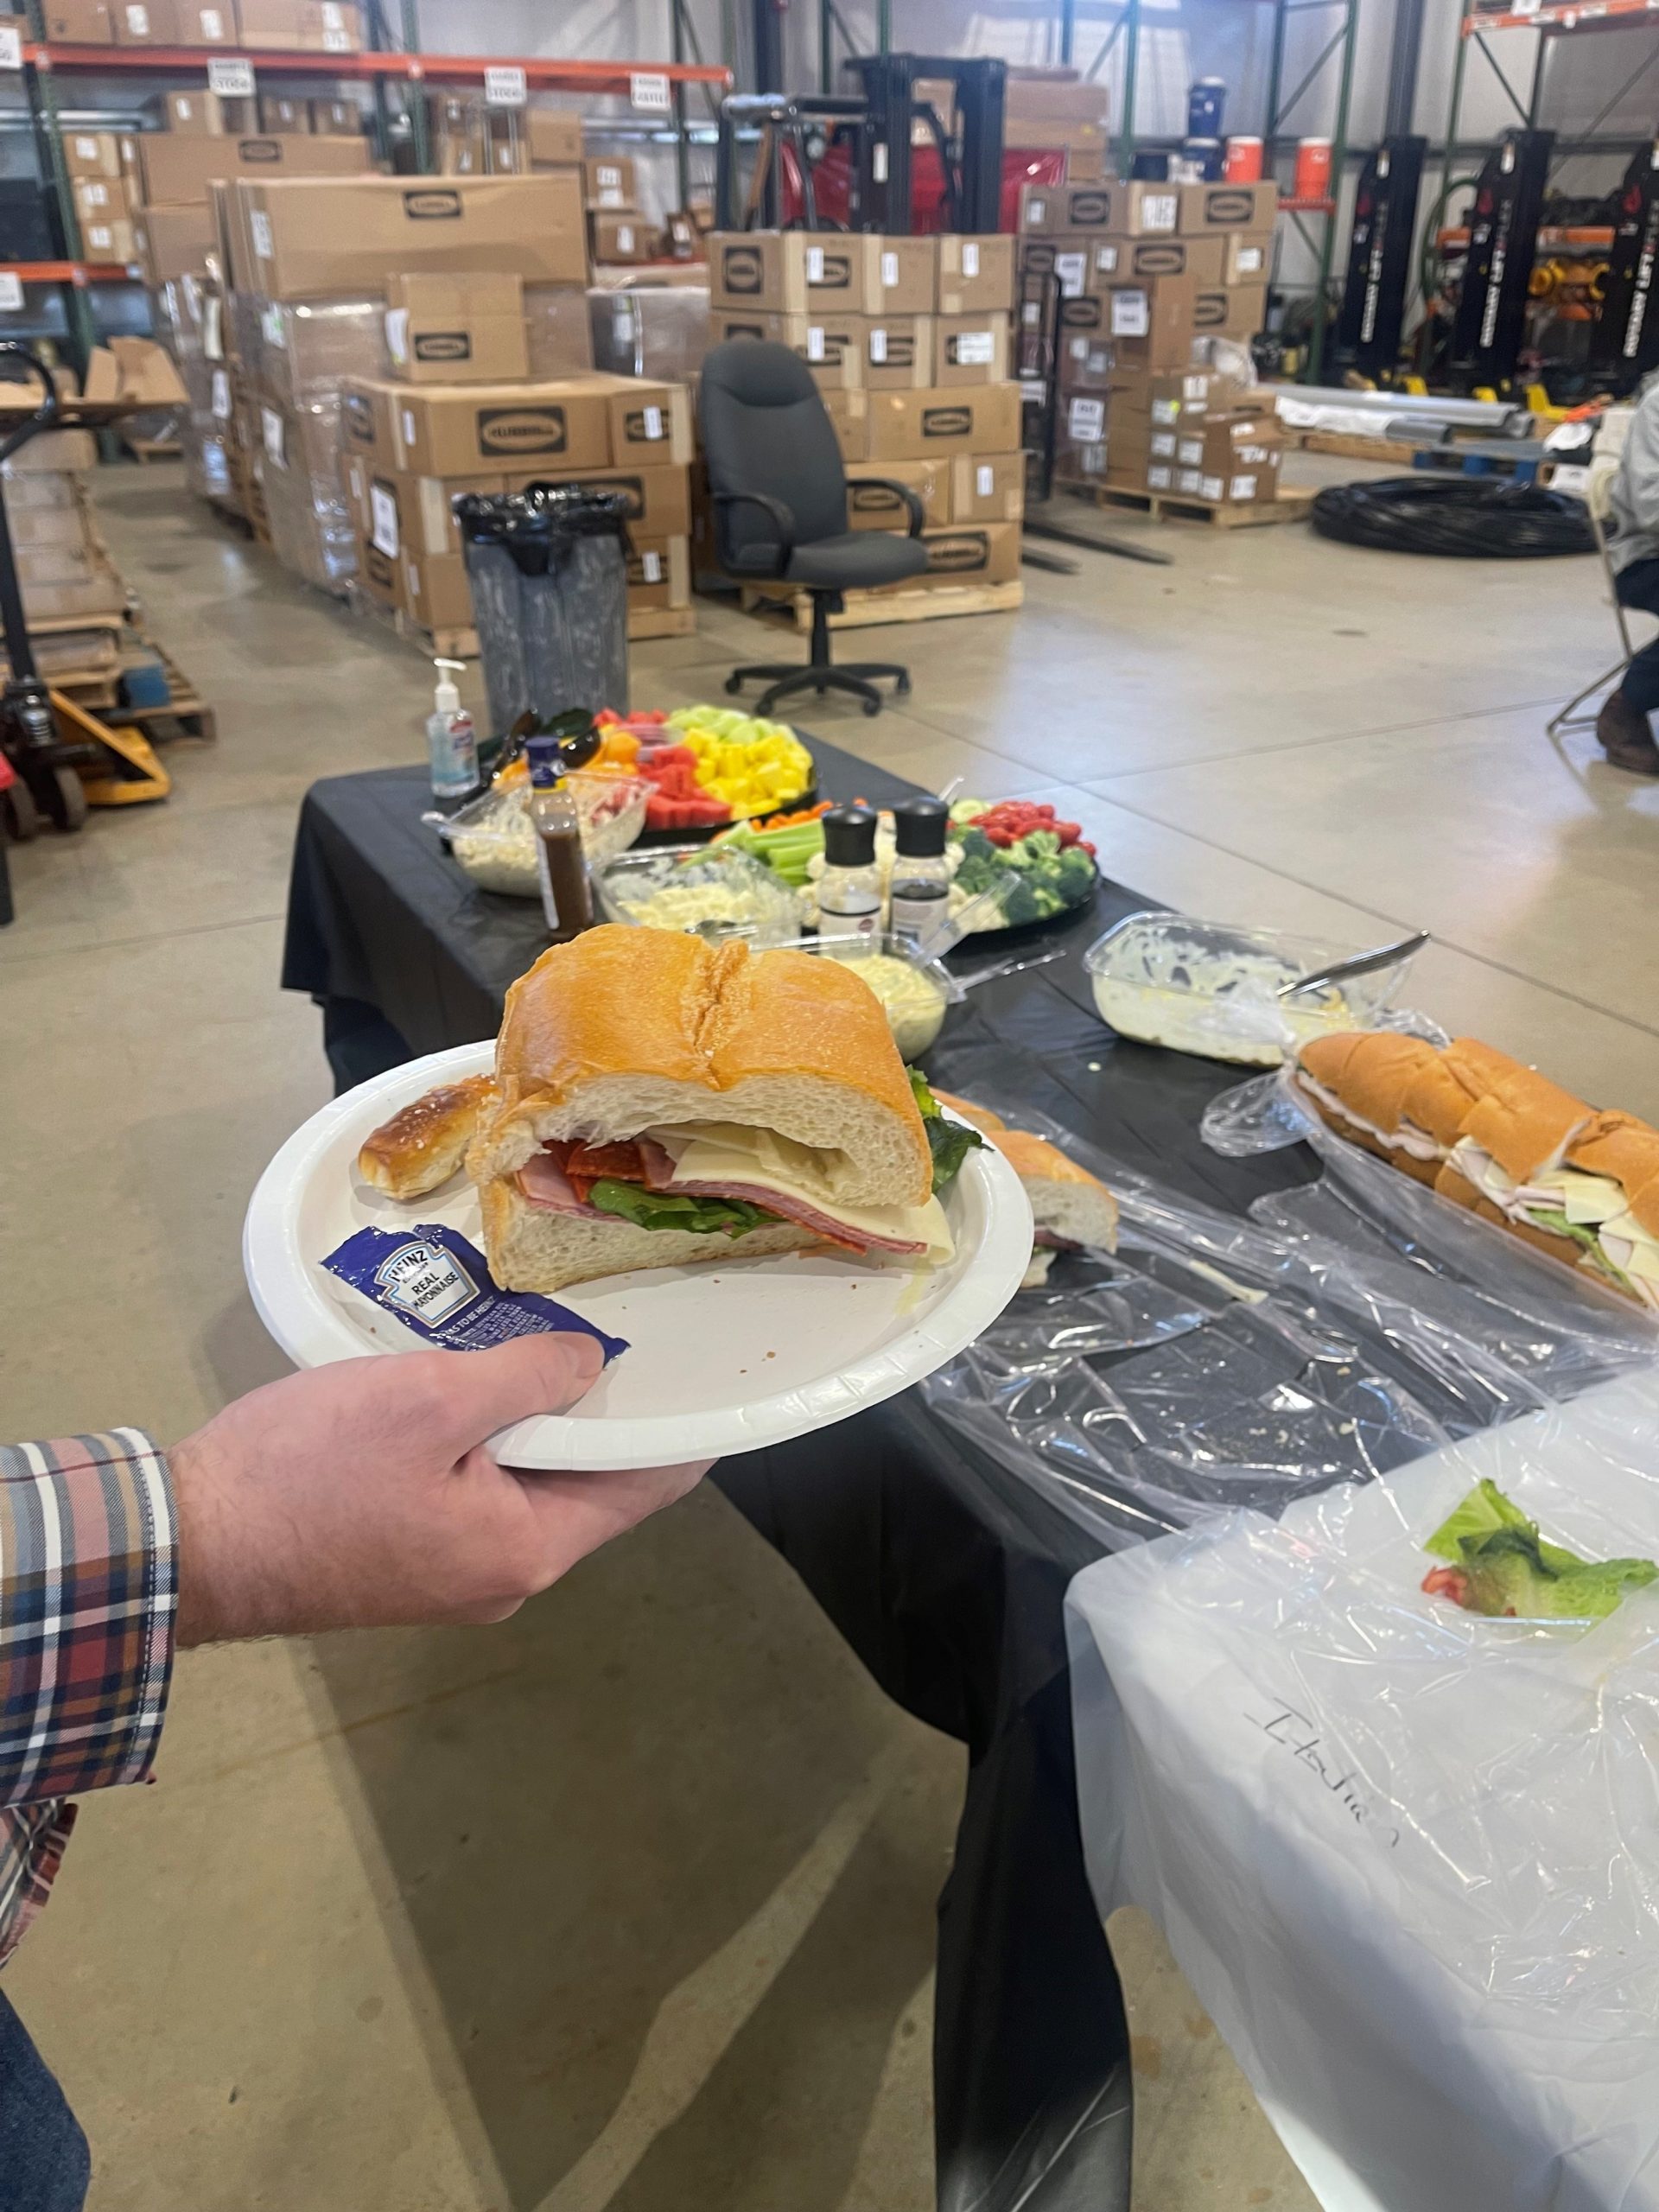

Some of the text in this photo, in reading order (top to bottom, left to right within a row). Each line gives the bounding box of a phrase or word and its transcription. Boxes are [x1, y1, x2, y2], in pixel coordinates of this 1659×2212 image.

[388, 1249, 428, 1282] HEINZ
[411, 1272, 440, 1295] REAL
[413, 1271, 460, 1309] MAYONNAISE
[455, 1317, 470, 1328] TO
[465, 1311, 479, 1320] BE
[475, 1295, 495, 1314] HEINZ
